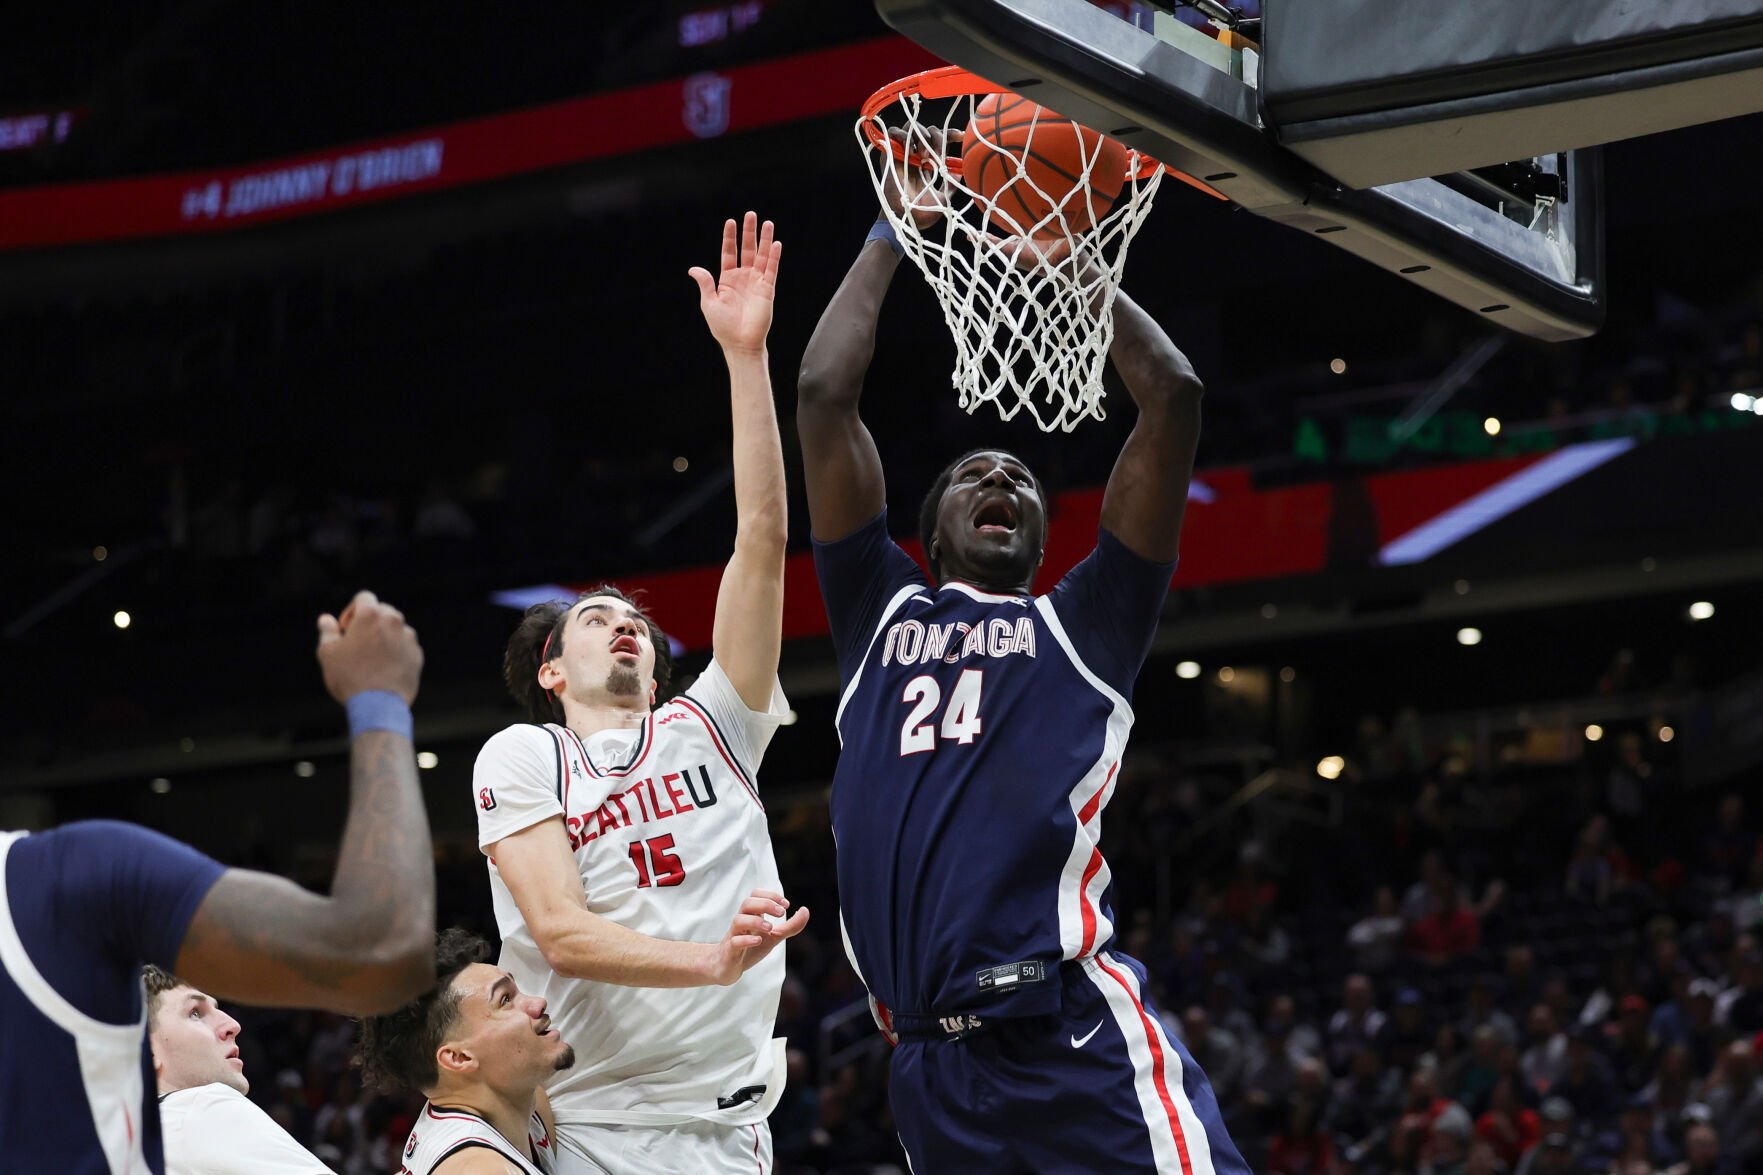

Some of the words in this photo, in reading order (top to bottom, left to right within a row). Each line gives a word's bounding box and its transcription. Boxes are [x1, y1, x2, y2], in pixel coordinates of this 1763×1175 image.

[225, 160, 331, 217] JOHNNY
[900, 669, 983, 757] 24
[628, 833, 685, 889] 15
[1022, 966, 1035, 976] 50
